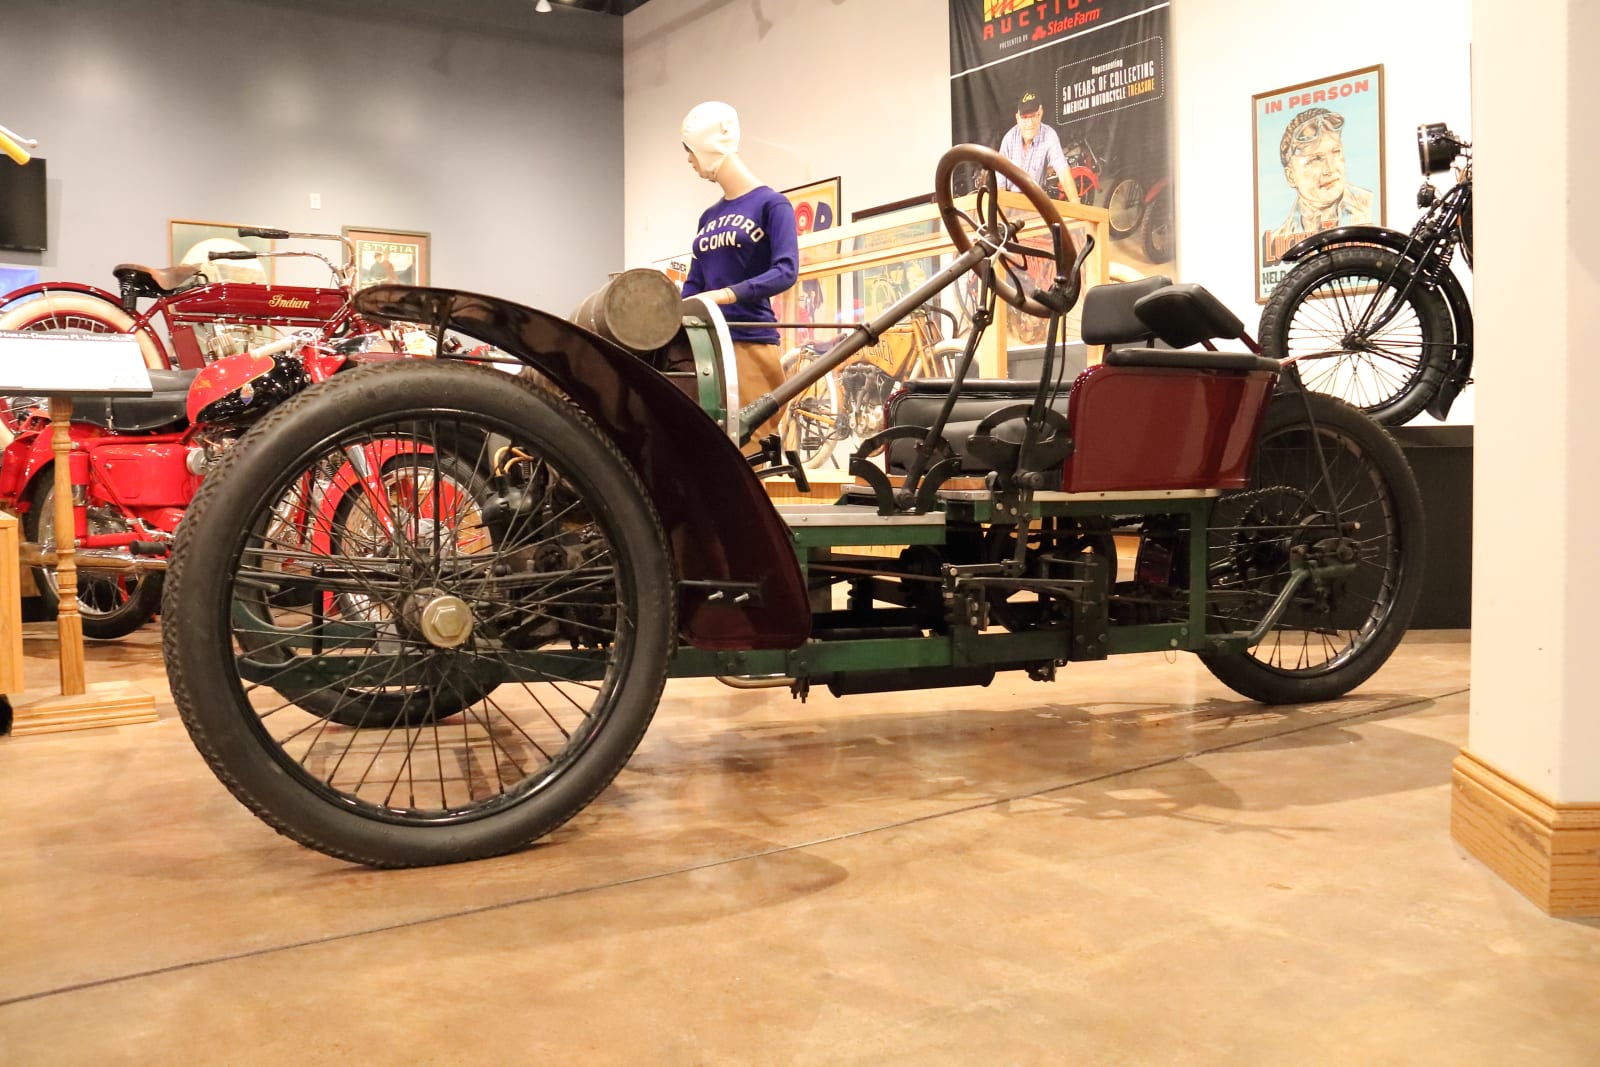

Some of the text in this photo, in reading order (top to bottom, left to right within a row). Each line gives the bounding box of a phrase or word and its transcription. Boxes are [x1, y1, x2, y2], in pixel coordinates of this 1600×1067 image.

[983, 0, 1093, 41] AUCTIO
[1000, 34, 1028, 49] PRESENTED BY
[1062, 60, 1154, 102] 50 YEARS OF COLLECTING
[1091, 58, 1123, 75] Representing
[1062, 78, 1155, 115] AMERICAN MOTORCYCLE TREASURE
[1265, 79, 1369, 114] IN PERSON
[696, 213, 765, 243] ARTFORD
[362, 242, 414, 253] STYRIA
[268, 294, 310, 310] Indian
